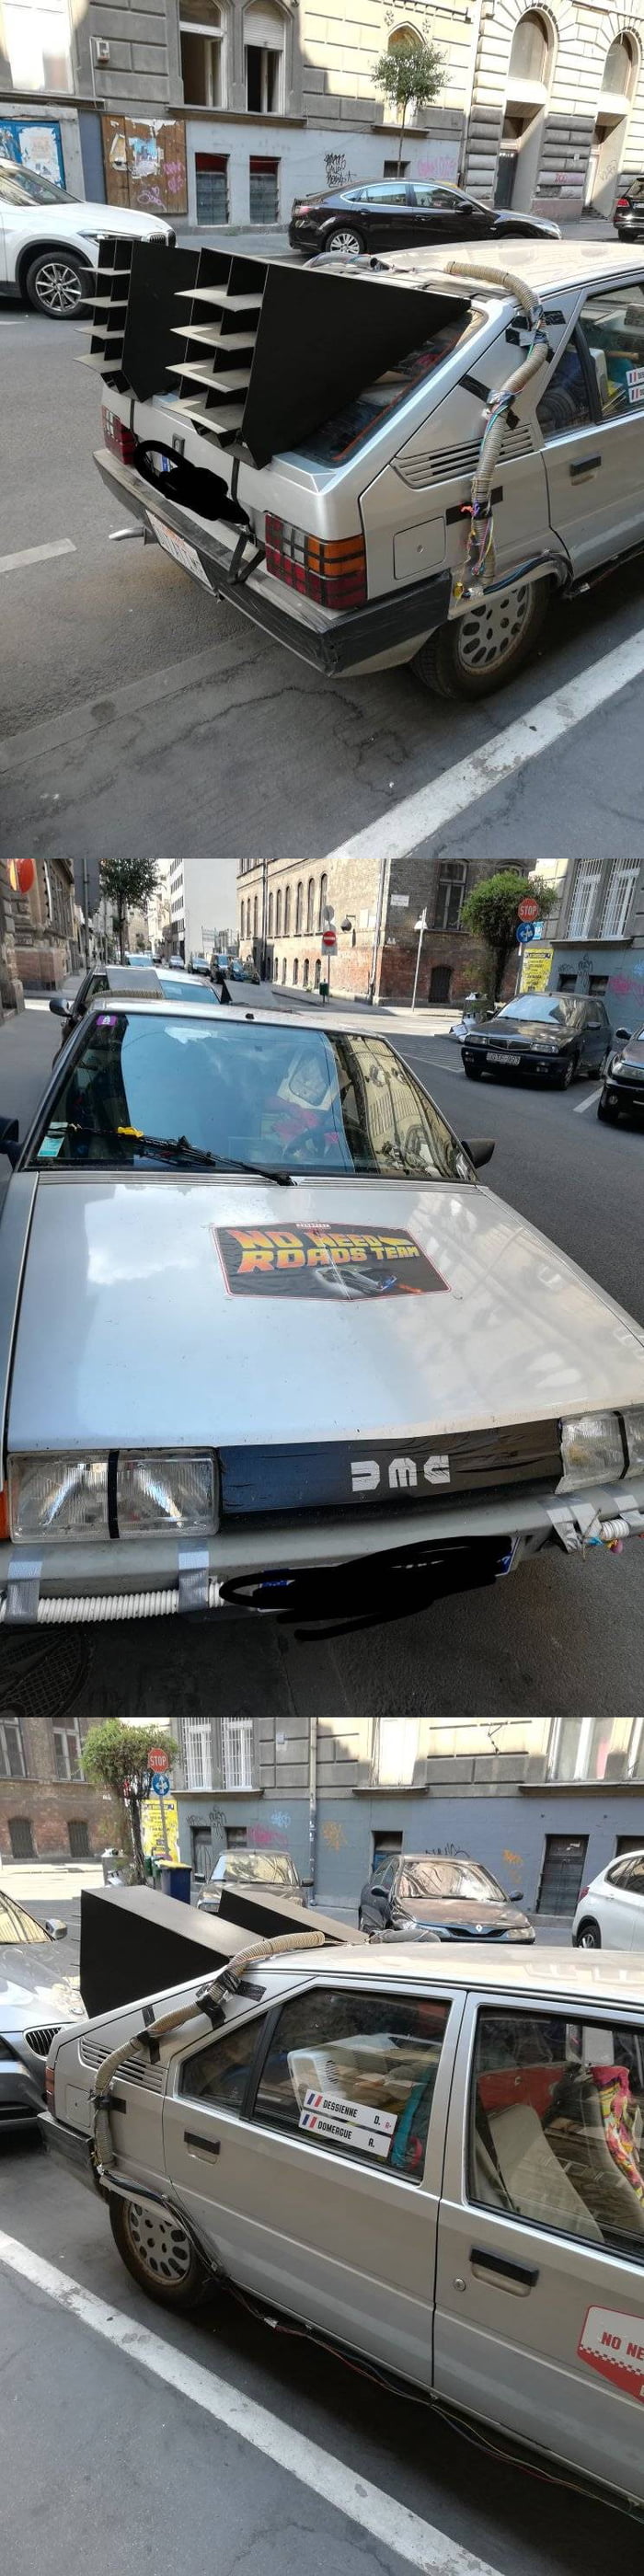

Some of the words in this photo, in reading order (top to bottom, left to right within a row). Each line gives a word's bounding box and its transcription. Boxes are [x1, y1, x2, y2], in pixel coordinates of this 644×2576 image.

[520, 906, 536, 915] STOP
[229, 1229, 304, 1249] NO
[305, 1231, 384, 1248] NEED
[236, 1248, 368, 1274] ROADS
[370, 1246, 420, 1260] TEAM
[149, 1755, 167, 1766] STOP
[323, 2099, 359, 2118] DESSIENNE
[374, 2115, 381, 2125] D.
[317, 2121, 353, 2140] DOMERGUE
[368, 2137, 375, 2148] A.
[601, 2331, 622, 2351] NO
